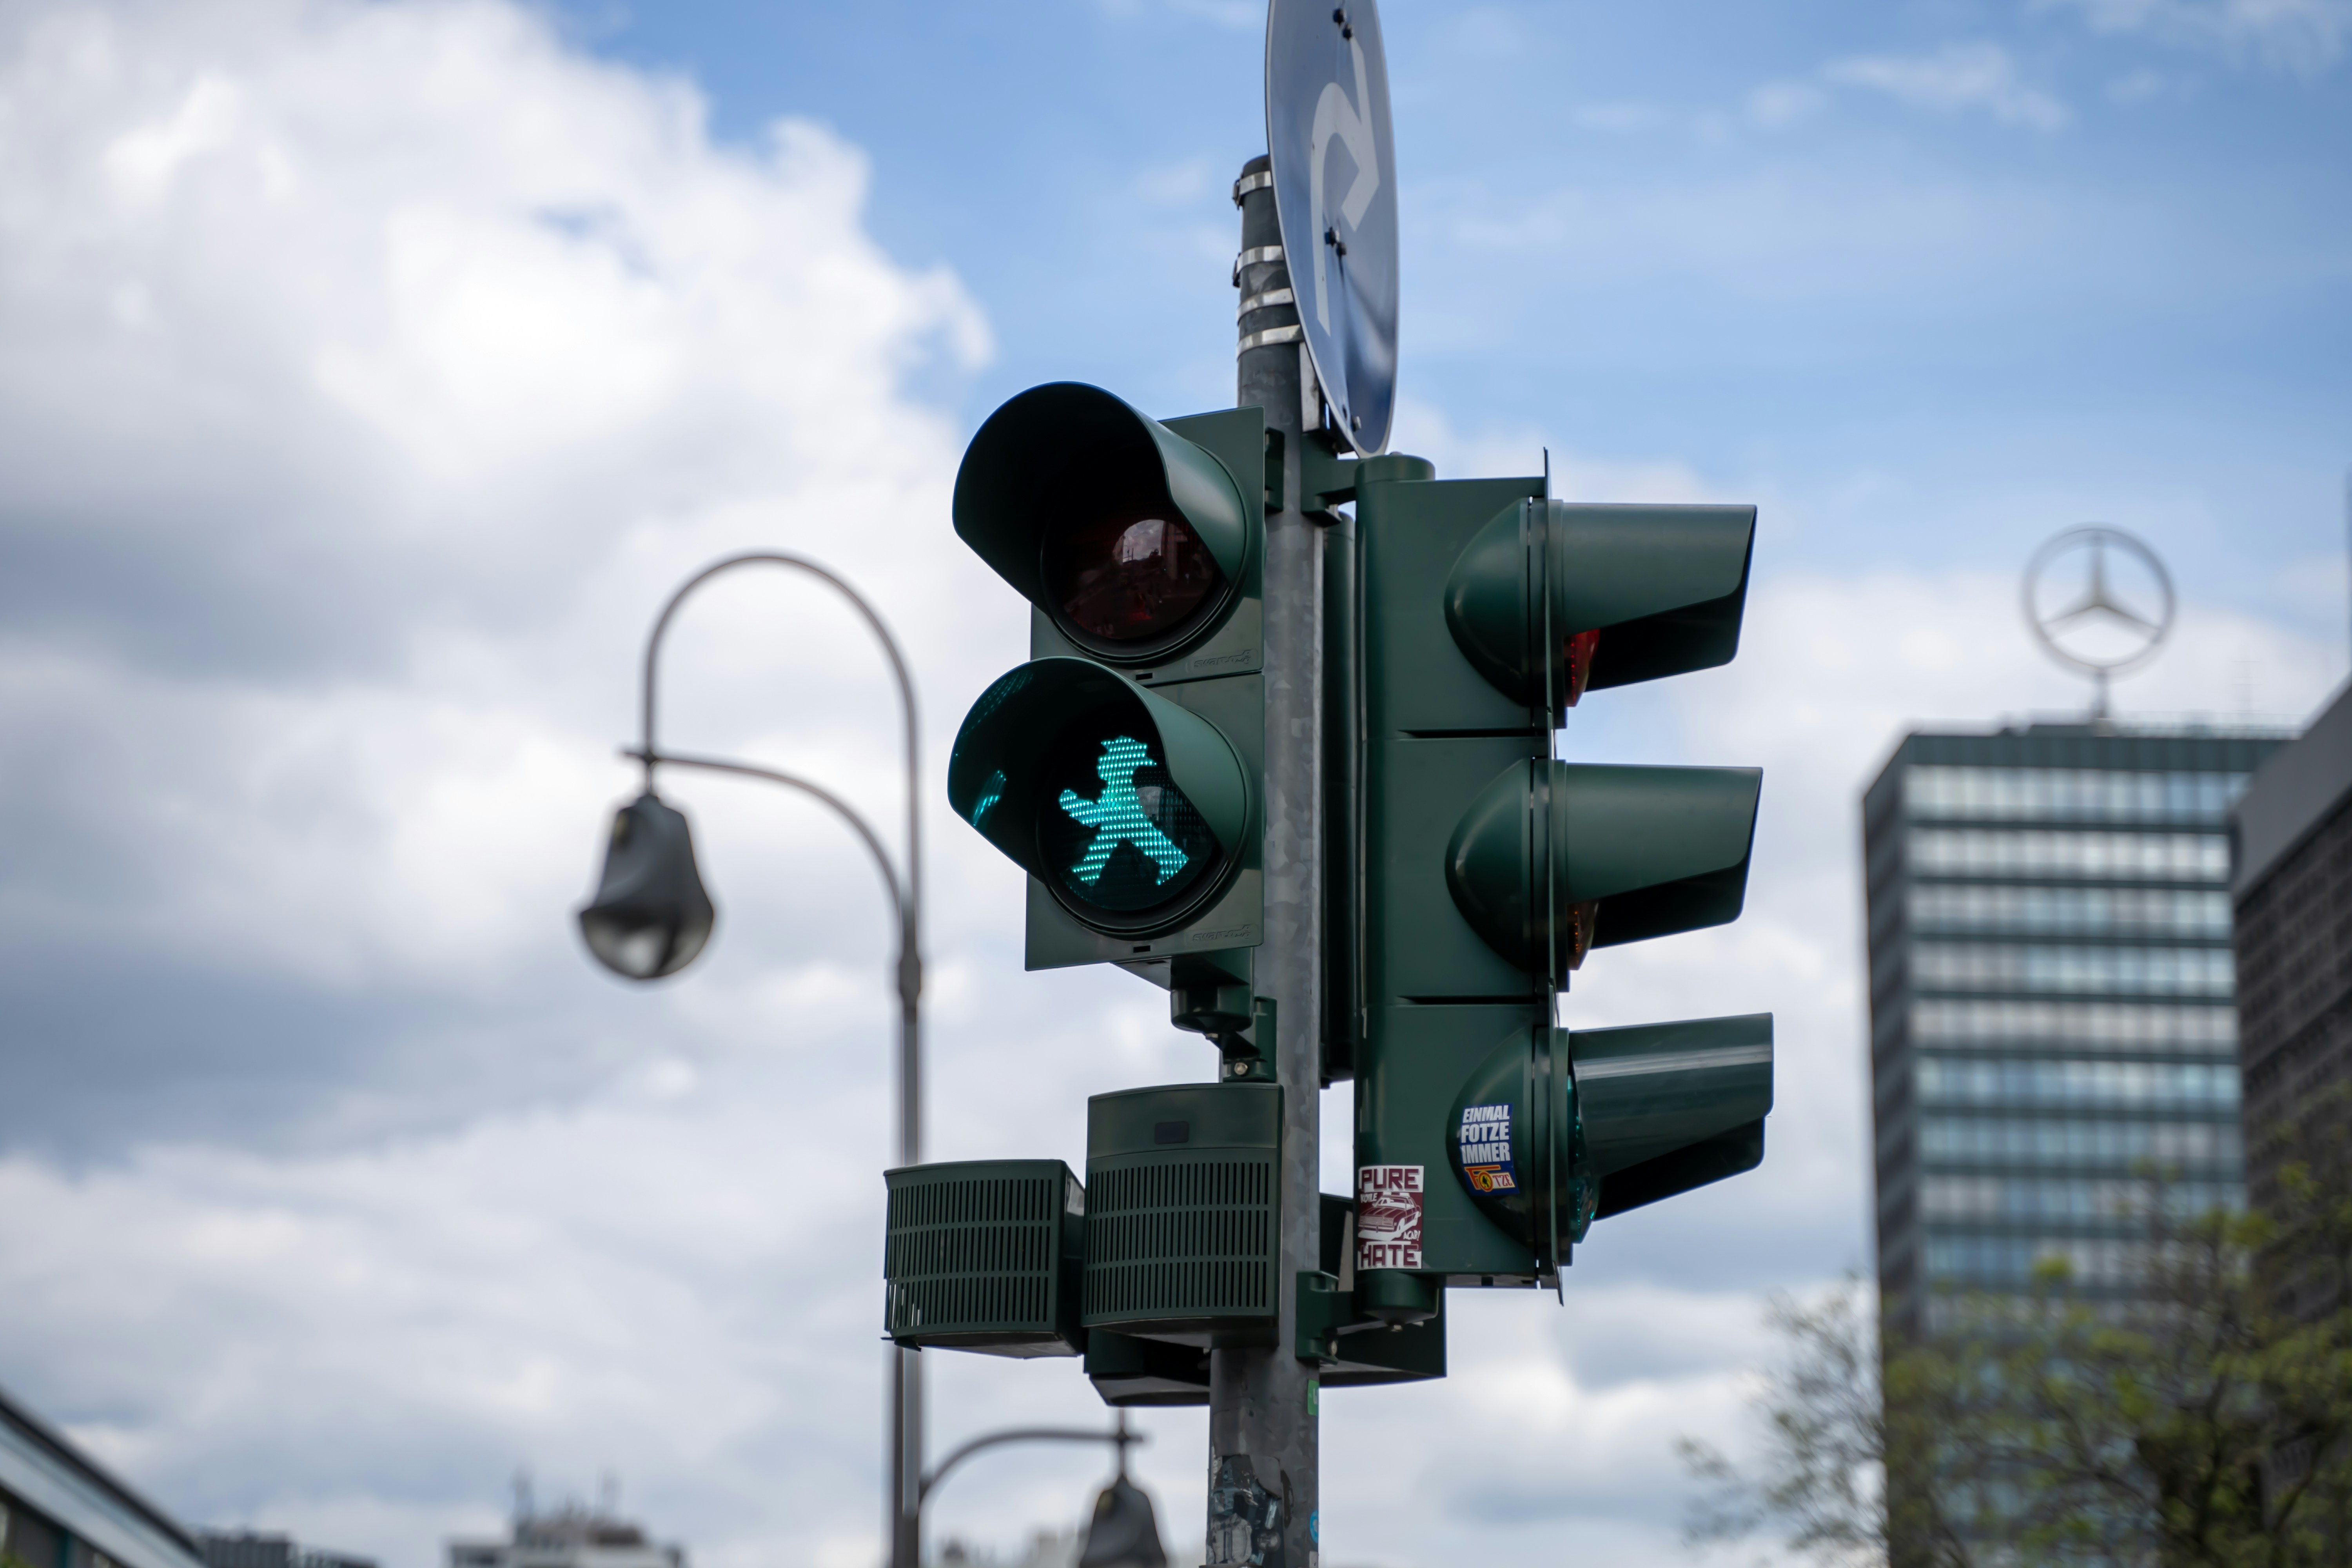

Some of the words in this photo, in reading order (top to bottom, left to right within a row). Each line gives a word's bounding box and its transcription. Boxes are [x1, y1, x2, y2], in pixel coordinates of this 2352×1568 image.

[1463, 1105, 1510, 1123] EINMAL
[1461, 1122, 1509, 1143] FOTZE
[1460, 1142, 1510, 1164] IMMER
[1361, 1168, 1419, 1191] PURE
[1361, 1244, 1418, 1267] HATE
